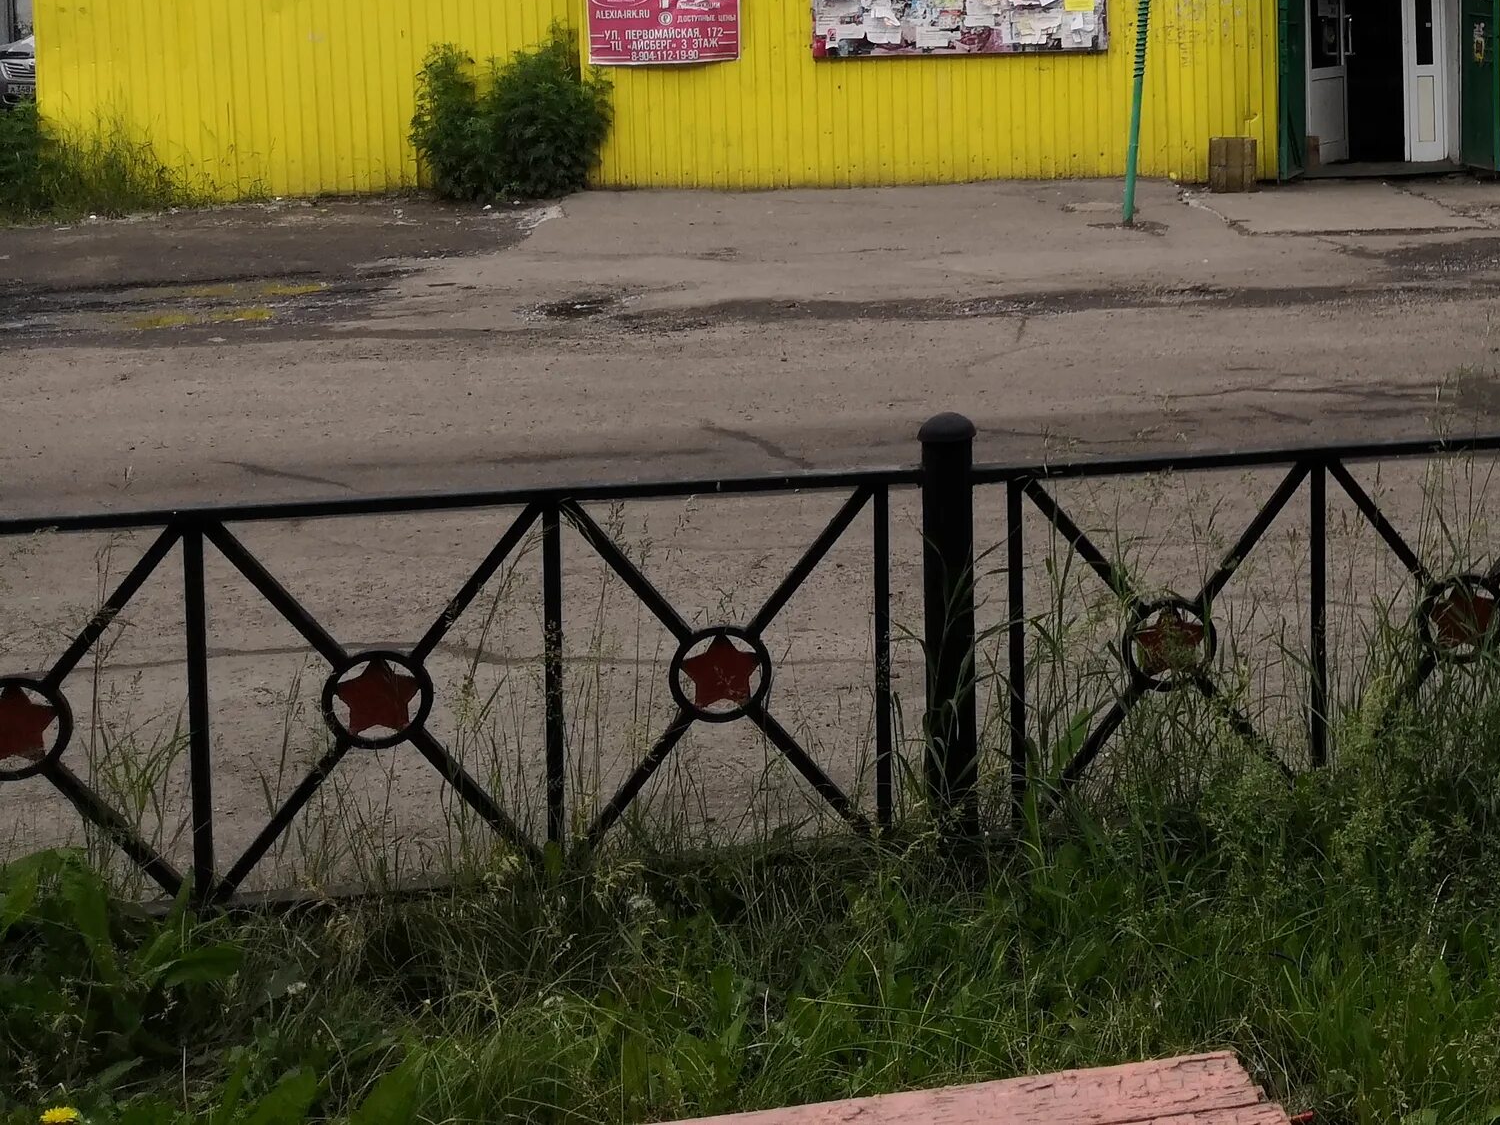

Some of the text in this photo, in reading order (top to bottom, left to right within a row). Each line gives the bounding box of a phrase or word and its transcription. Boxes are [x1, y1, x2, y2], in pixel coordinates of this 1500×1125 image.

[677, 14, 716, 23] ДОСТУПНЫЕ
[604, 29, 621, 40] УЛ.
[707, 27, 724, 37] 172
[610, 41, 623, 51] ТЦ
[681, 39, 687, 48] 3
[692, 37, 718, 49] ЭТАЖ
